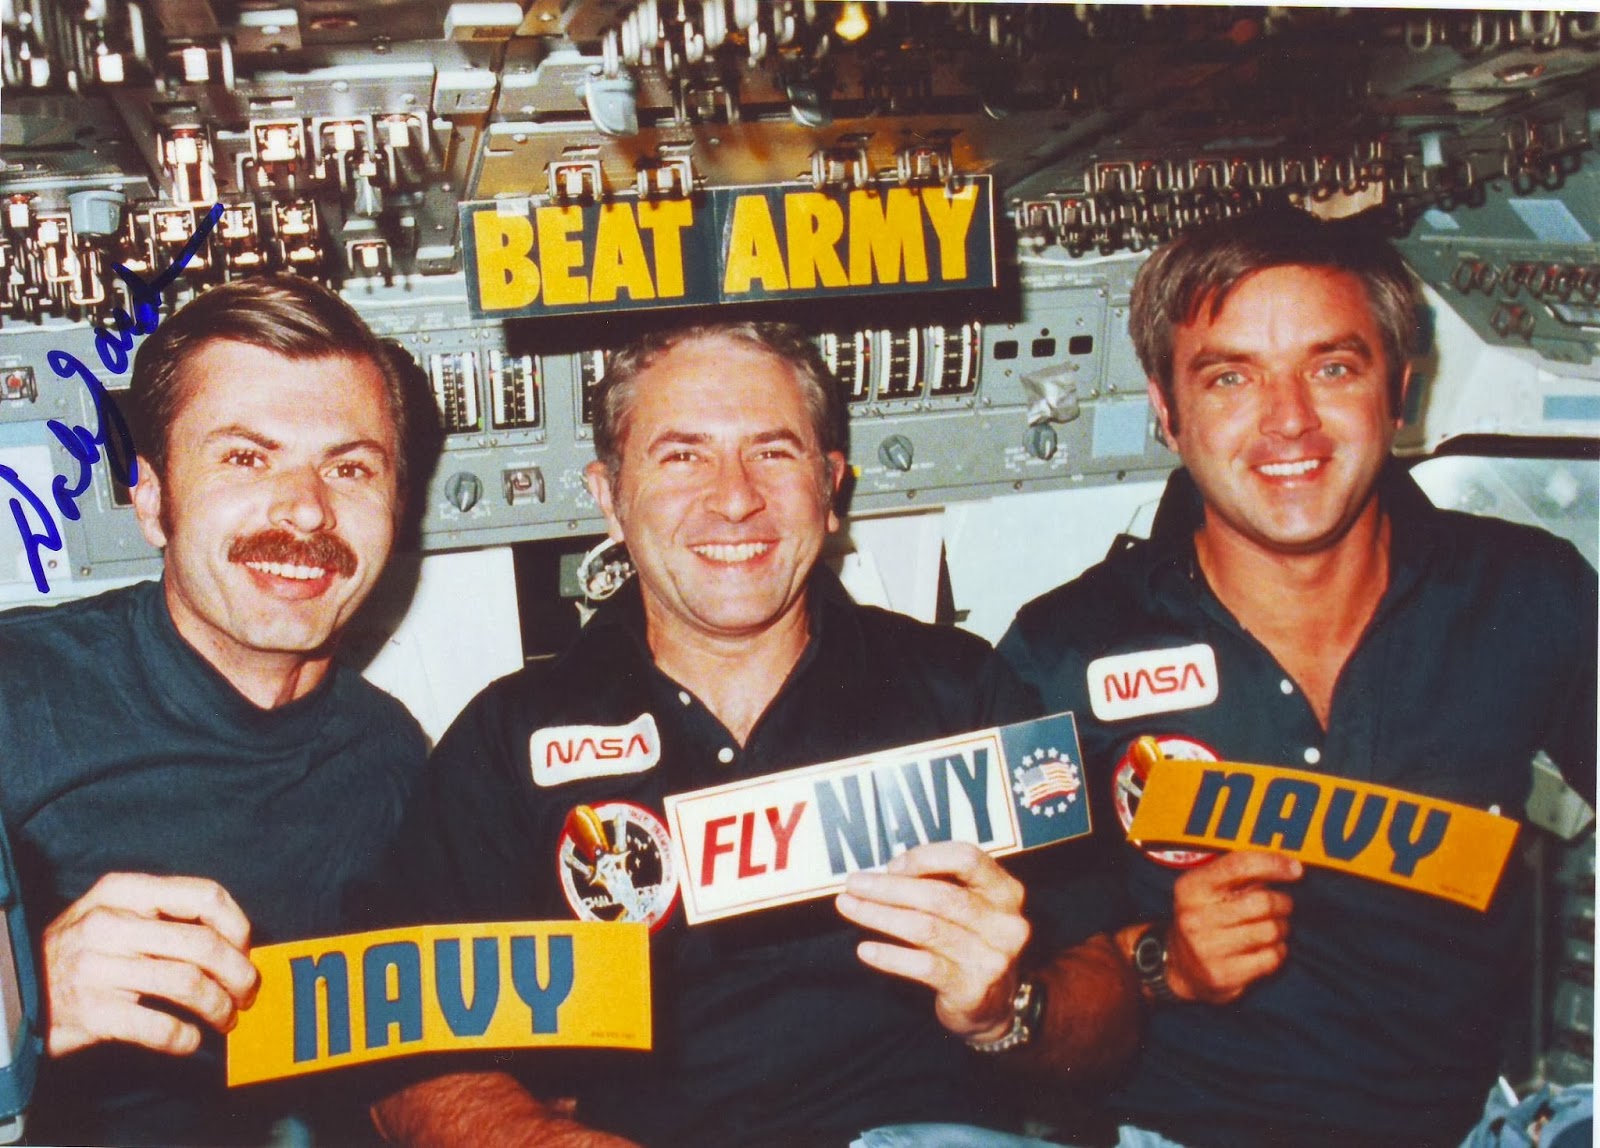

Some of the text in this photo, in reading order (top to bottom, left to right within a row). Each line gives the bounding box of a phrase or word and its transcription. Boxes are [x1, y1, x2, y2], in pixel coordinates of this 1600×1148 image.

[473, 184, 979, 310] BEAT ARMY
[1103, 662, 1206, 703] NASA
[546, 733, 650, 768] NASA
[700, 801, 808, 888] FLY
[813, 747, 995, 877] NAVY
[1184, 769, 1452, 879] NAVY
[289, 934, 575, 1064] NAVY
